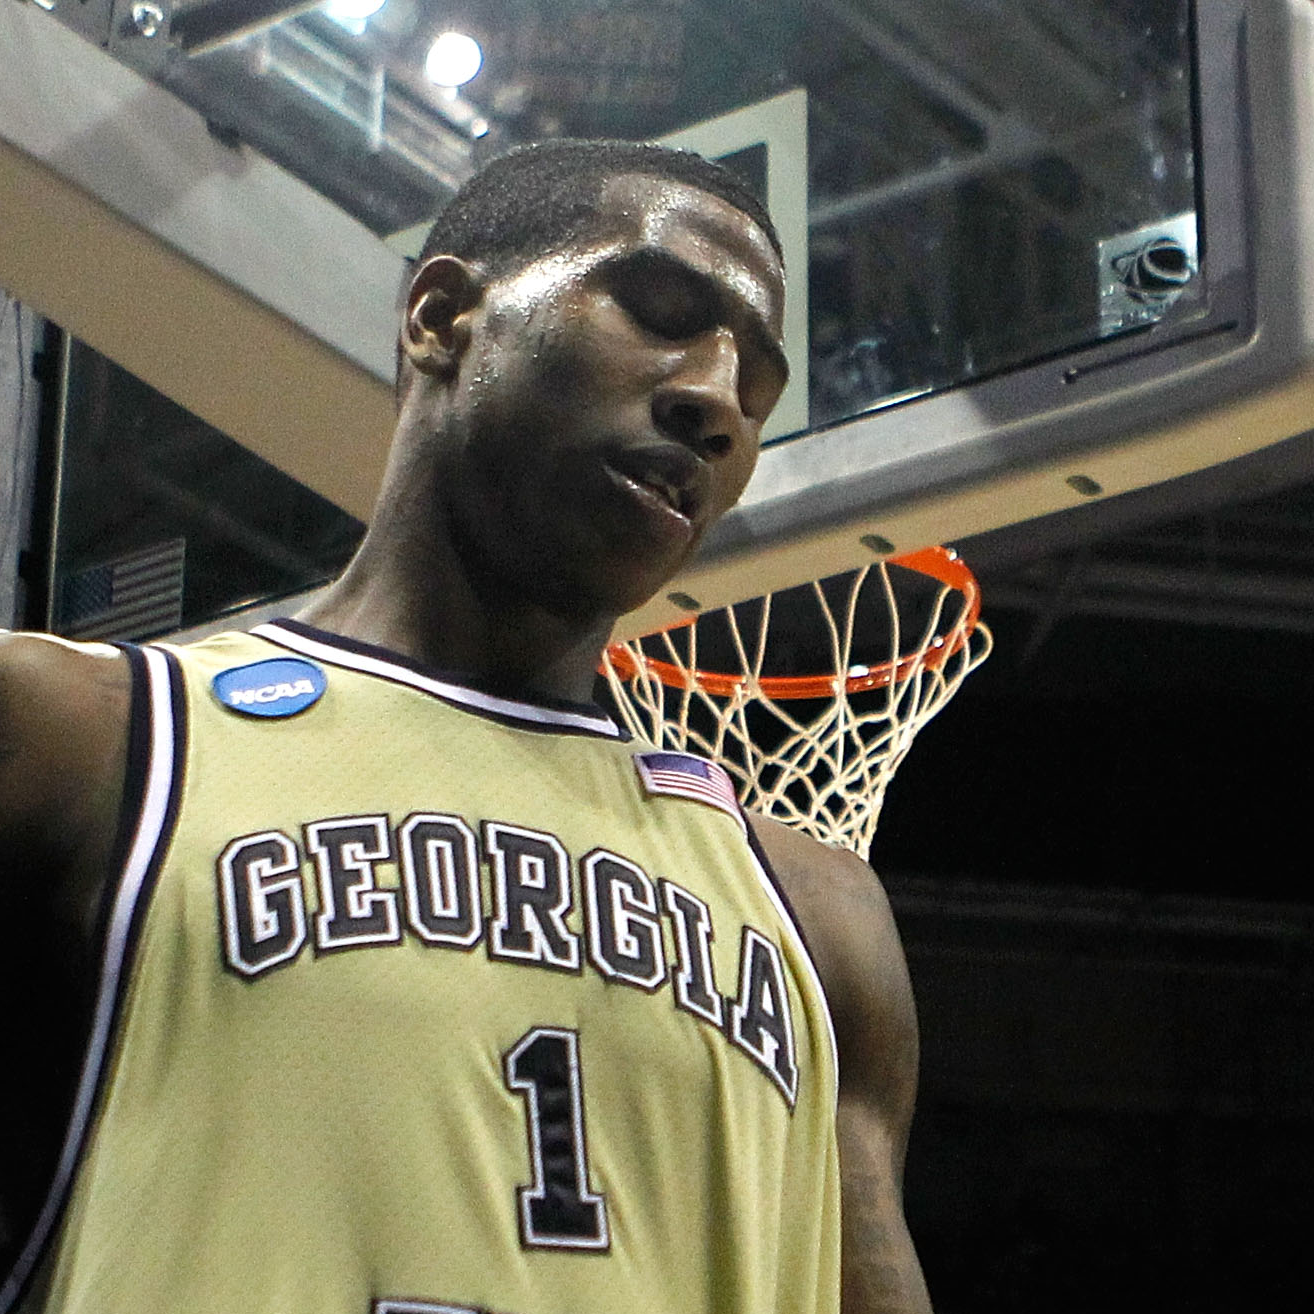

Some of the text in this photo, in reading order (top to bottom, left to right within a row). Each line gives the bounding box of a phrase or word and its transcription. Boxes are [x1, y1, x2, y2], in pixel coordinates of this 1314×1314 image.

[229, 678, 316, 705] NCAA
[217, 812, 799, 1112] GEORGIA
[505, 1026, 611, 1251] 1
